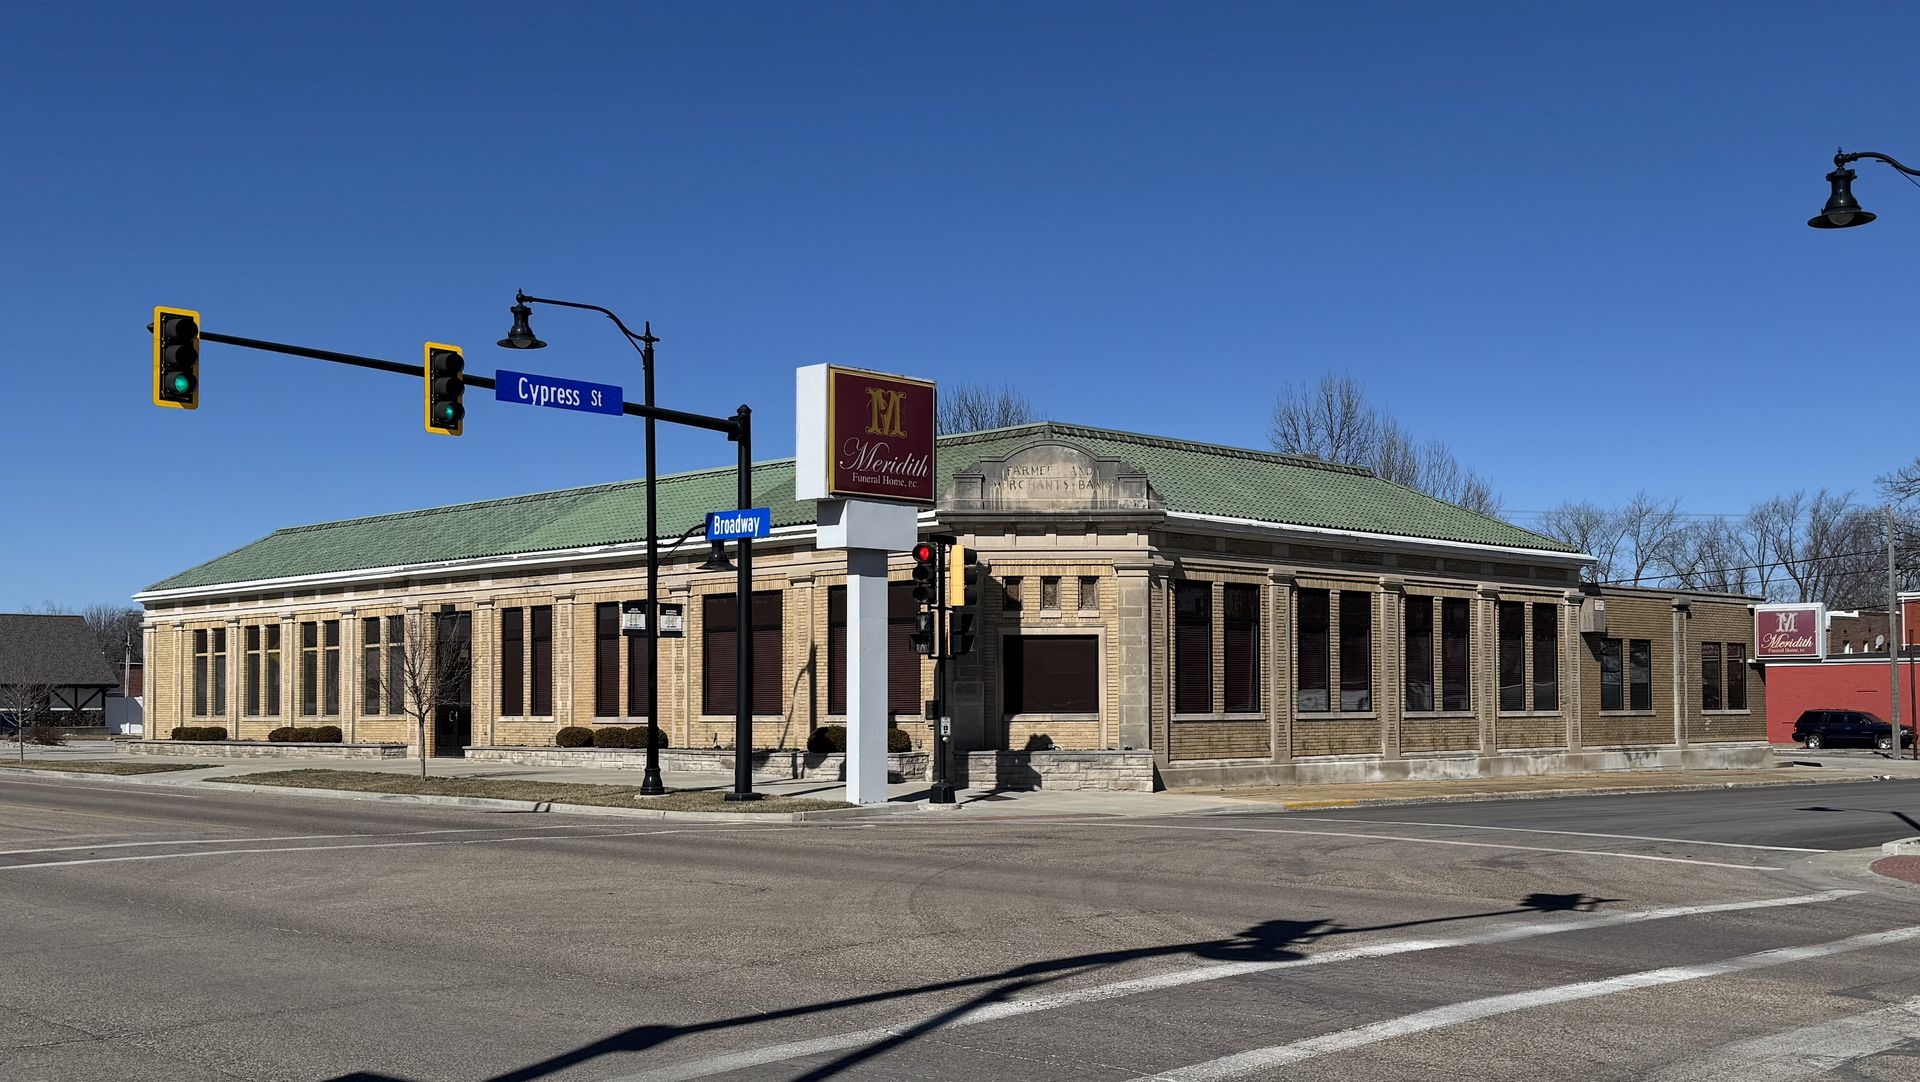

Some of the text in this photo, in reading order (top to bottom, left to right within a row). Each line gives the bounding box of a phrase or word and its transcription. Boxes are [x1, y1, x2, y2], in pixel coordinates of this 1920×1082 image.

[518, 377, 602, 407] Cypress St
[839, 437, 929, 478] Meridith
[852, 472, 880, 484] Funeral
[714, 513, 760, 537] Broadway
[1761, 633, 1814, 648] Meridith
